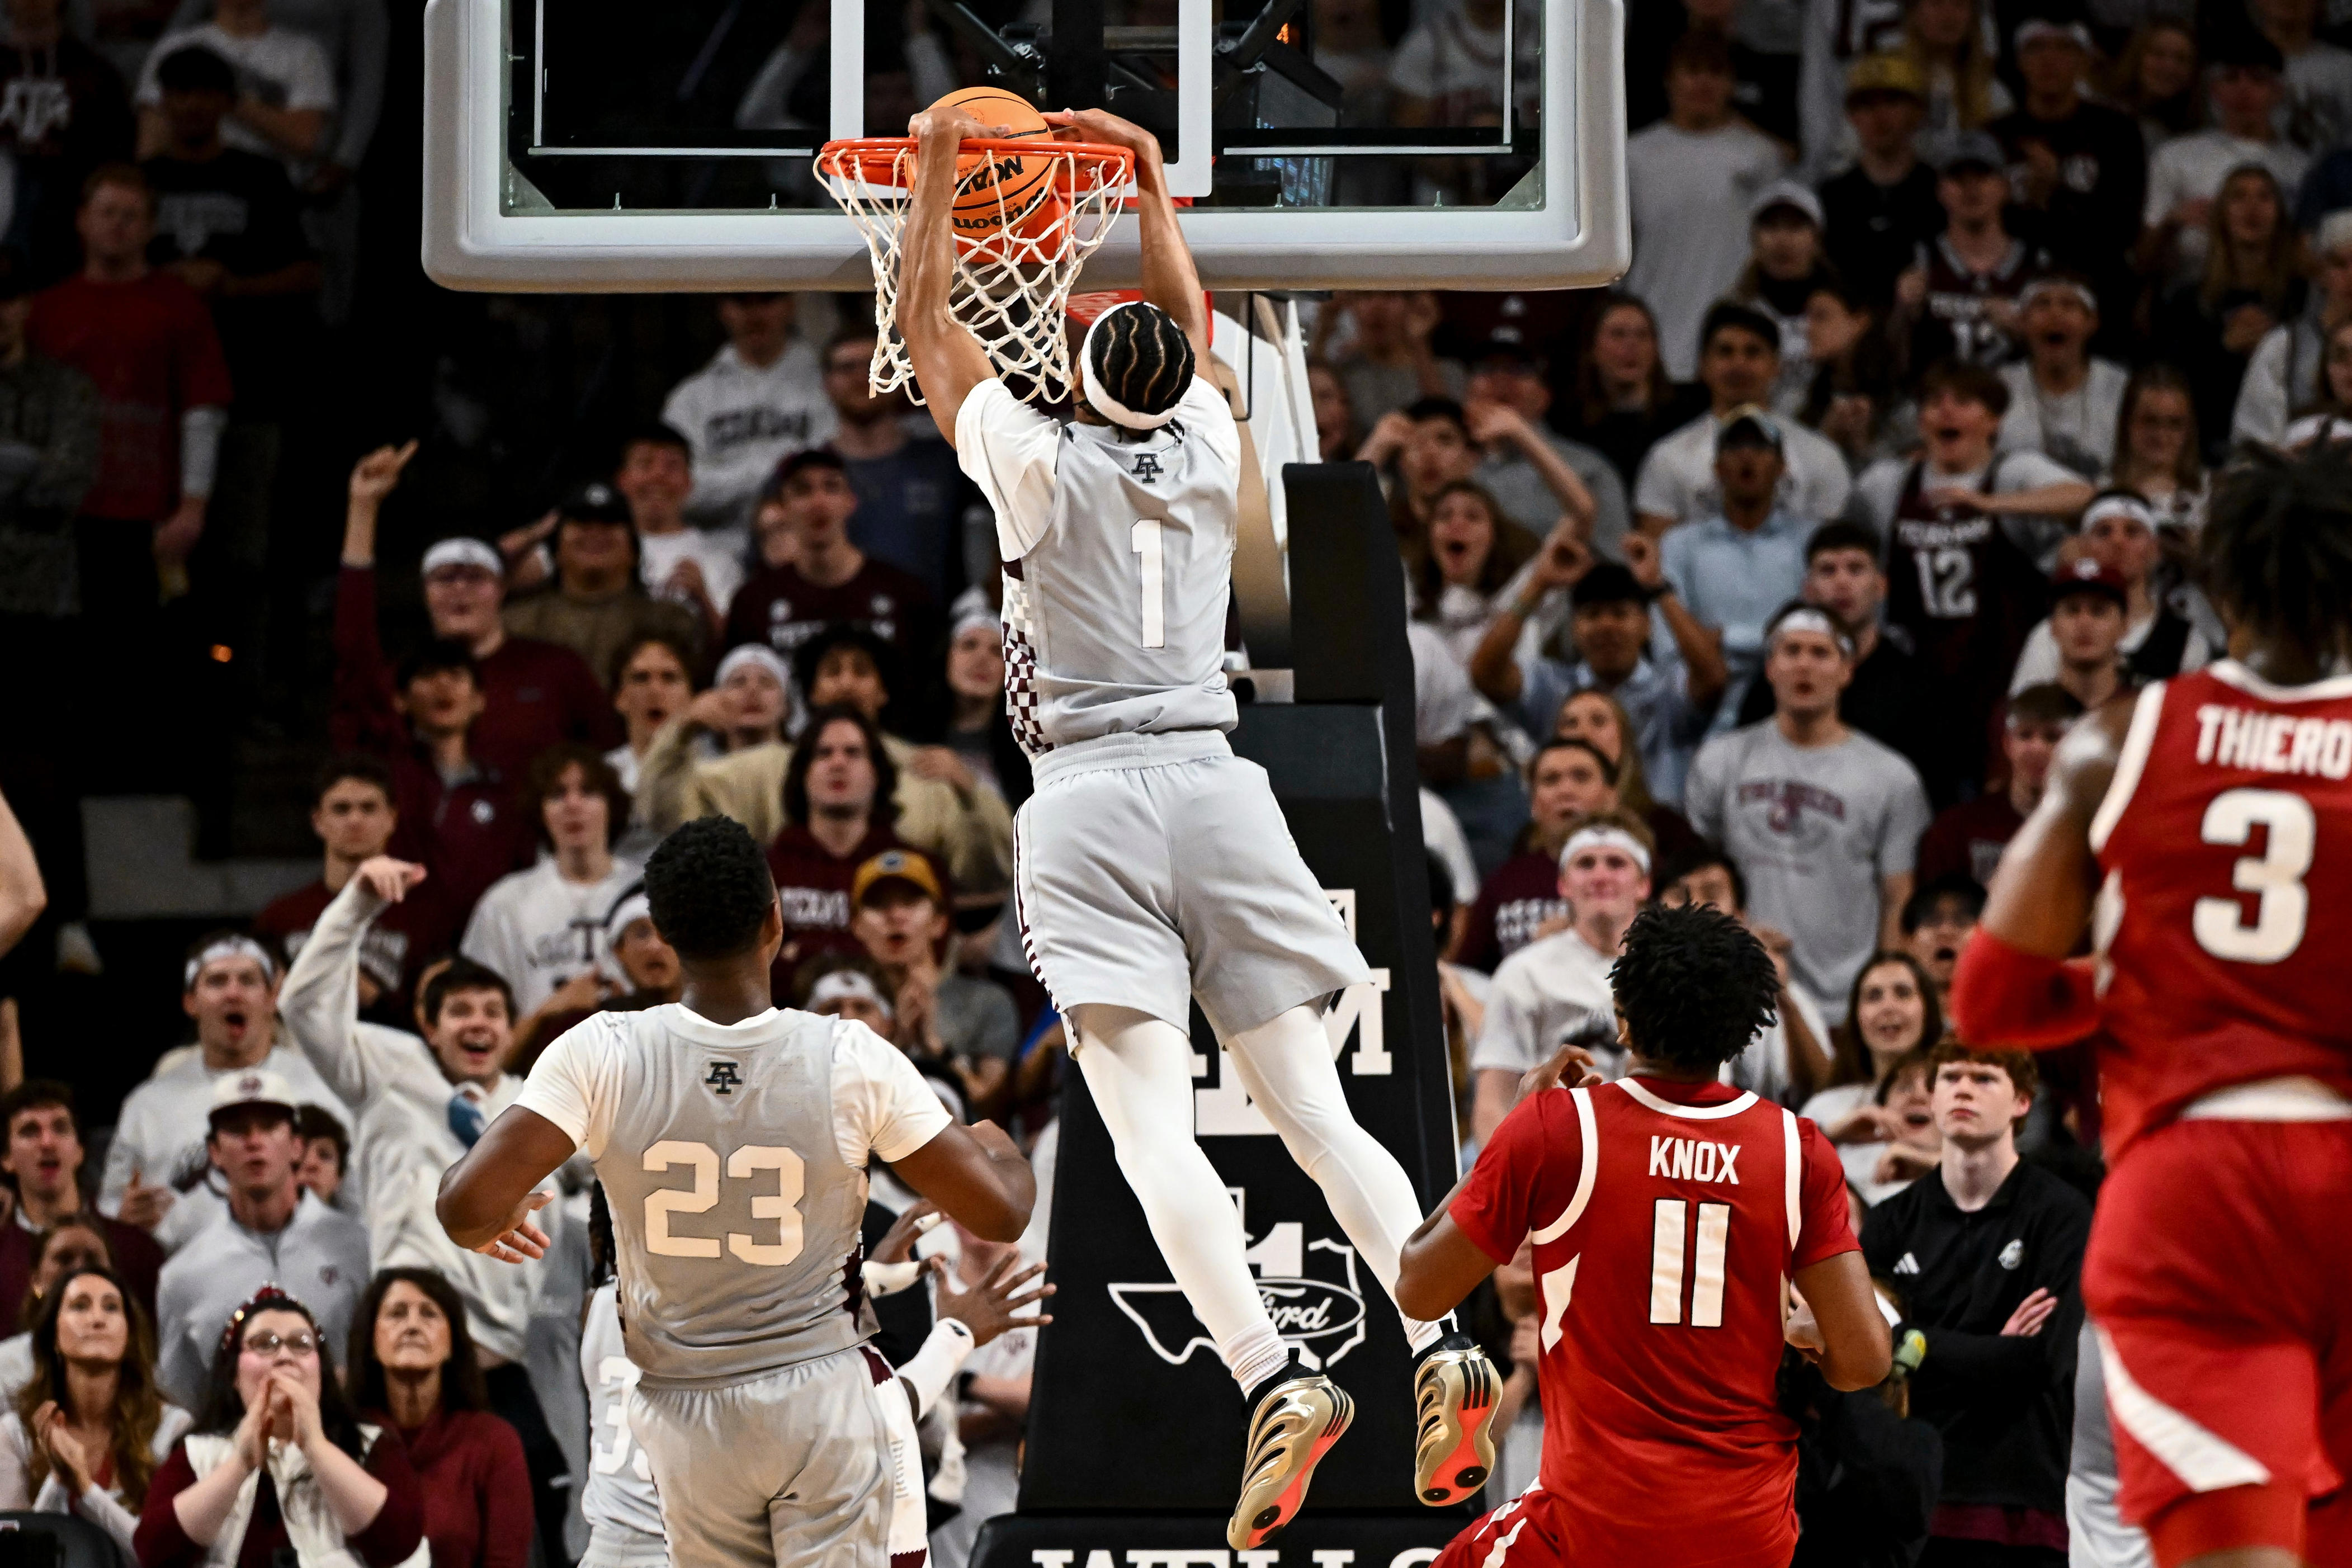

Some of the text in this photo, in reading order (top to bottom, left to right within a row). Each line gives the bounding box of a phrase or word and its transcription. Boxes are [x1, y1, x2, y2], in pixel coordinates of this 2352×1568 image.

[1131, 519, 1164, 648] 1
[1912, 550, 1978, 618] 12
[2195, 703, 2352, 781] THIERO
[2193, 787, 2316, 965] 3
[643, 1140, 805, 1266] 23
[1649, 1135, 1741, 1186] KNOX
[1650, 1198, 1732, 1328] 11
[595, 1356, 651, 1481] 3
